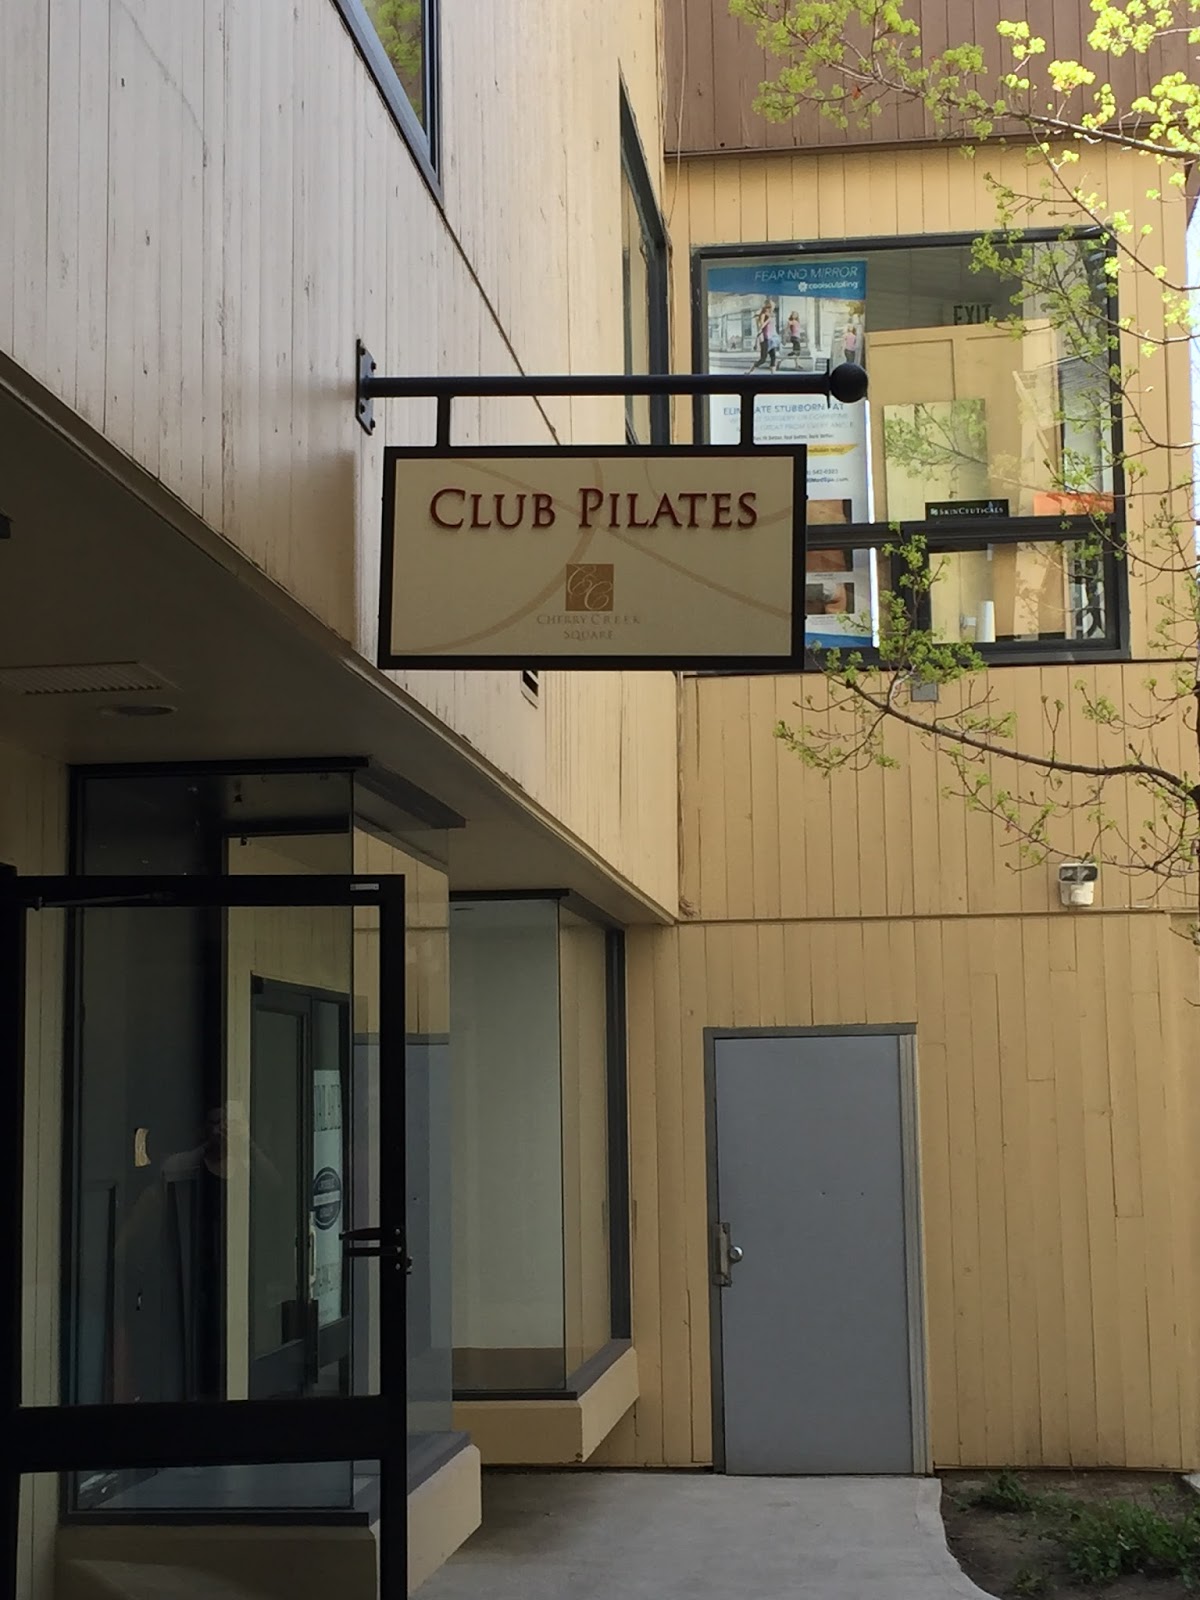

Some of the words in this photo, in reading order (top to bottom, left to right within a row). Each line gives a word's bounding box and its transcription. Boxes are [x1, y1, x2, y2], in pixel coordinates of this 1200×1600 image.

[755, 270, 785, 281] FEAR
[787, 268, 808, 280] NO
[810, 266, 858, 279] MIRROR
[774, 402, 825, 413] STUBBORN
[430, 488, 556, 529] CLUB
[578, 487, 758, 529] PILATES
[537, 614, 587, 625] CHERRY
[591, 614, 640, 625] CREEK
[563, 630, 614, 641] SQUARE
